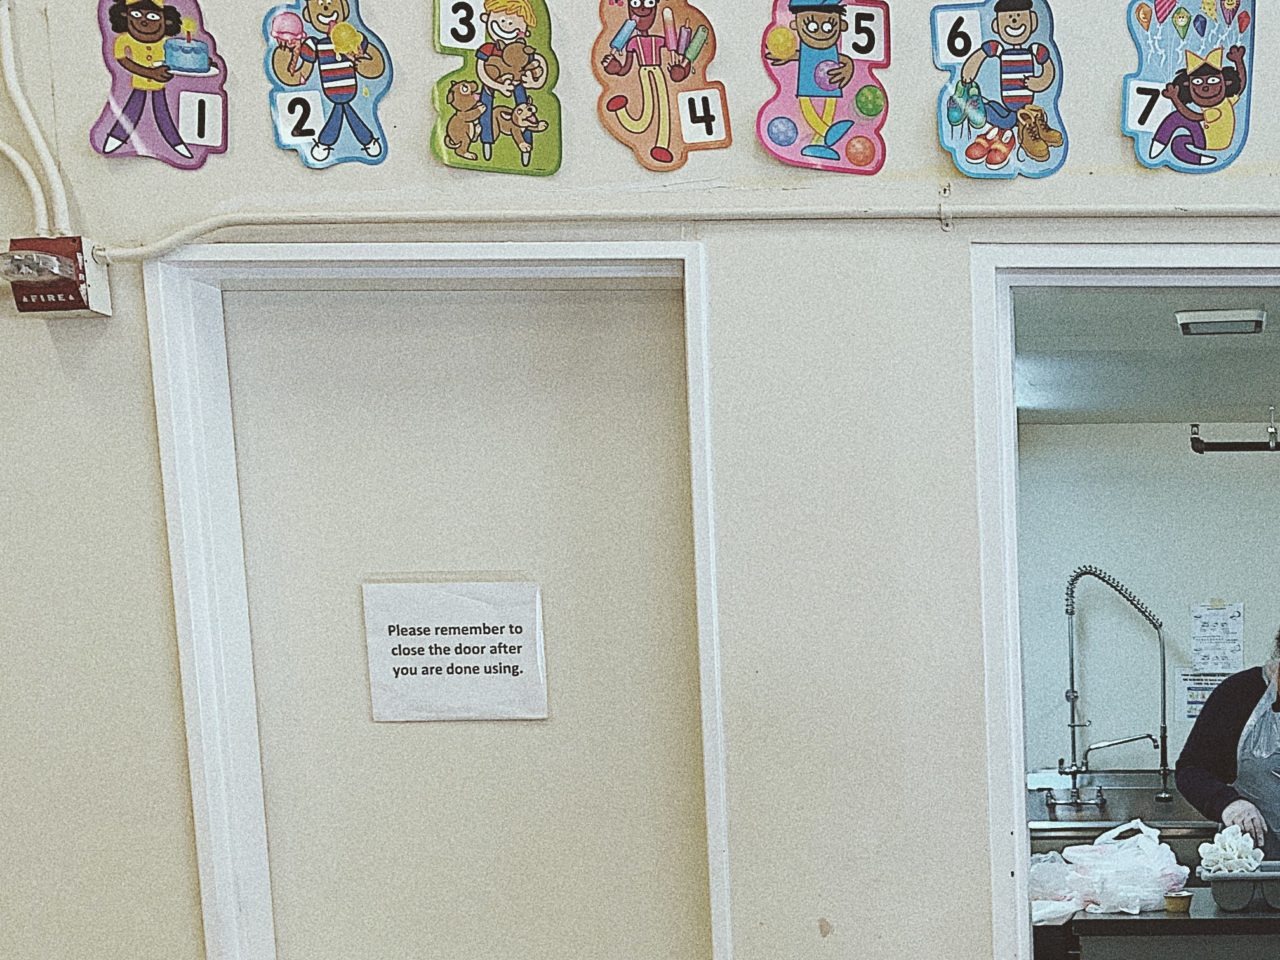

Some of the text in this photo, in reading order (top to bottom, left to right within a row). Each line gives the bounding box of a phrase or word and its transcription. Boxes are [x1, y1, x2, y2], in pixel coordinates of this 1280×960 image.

[450, 2, 476, 43] 3
[854, 13, 877, 54] 5
[946, 16, 972, 58] 6
[196, 98, 207, 139] 1
[287, 96, 316, 138] 2
[690, 96, 715, 136] 4
[1135, 87, 1161, 126] 7
[31, 294, 66, 303] FIRE
[387, 623, 523, 636] Please remember to
[391, 642, 523, 656] close the door after
[393, 662, 524, 678] you are done using.
